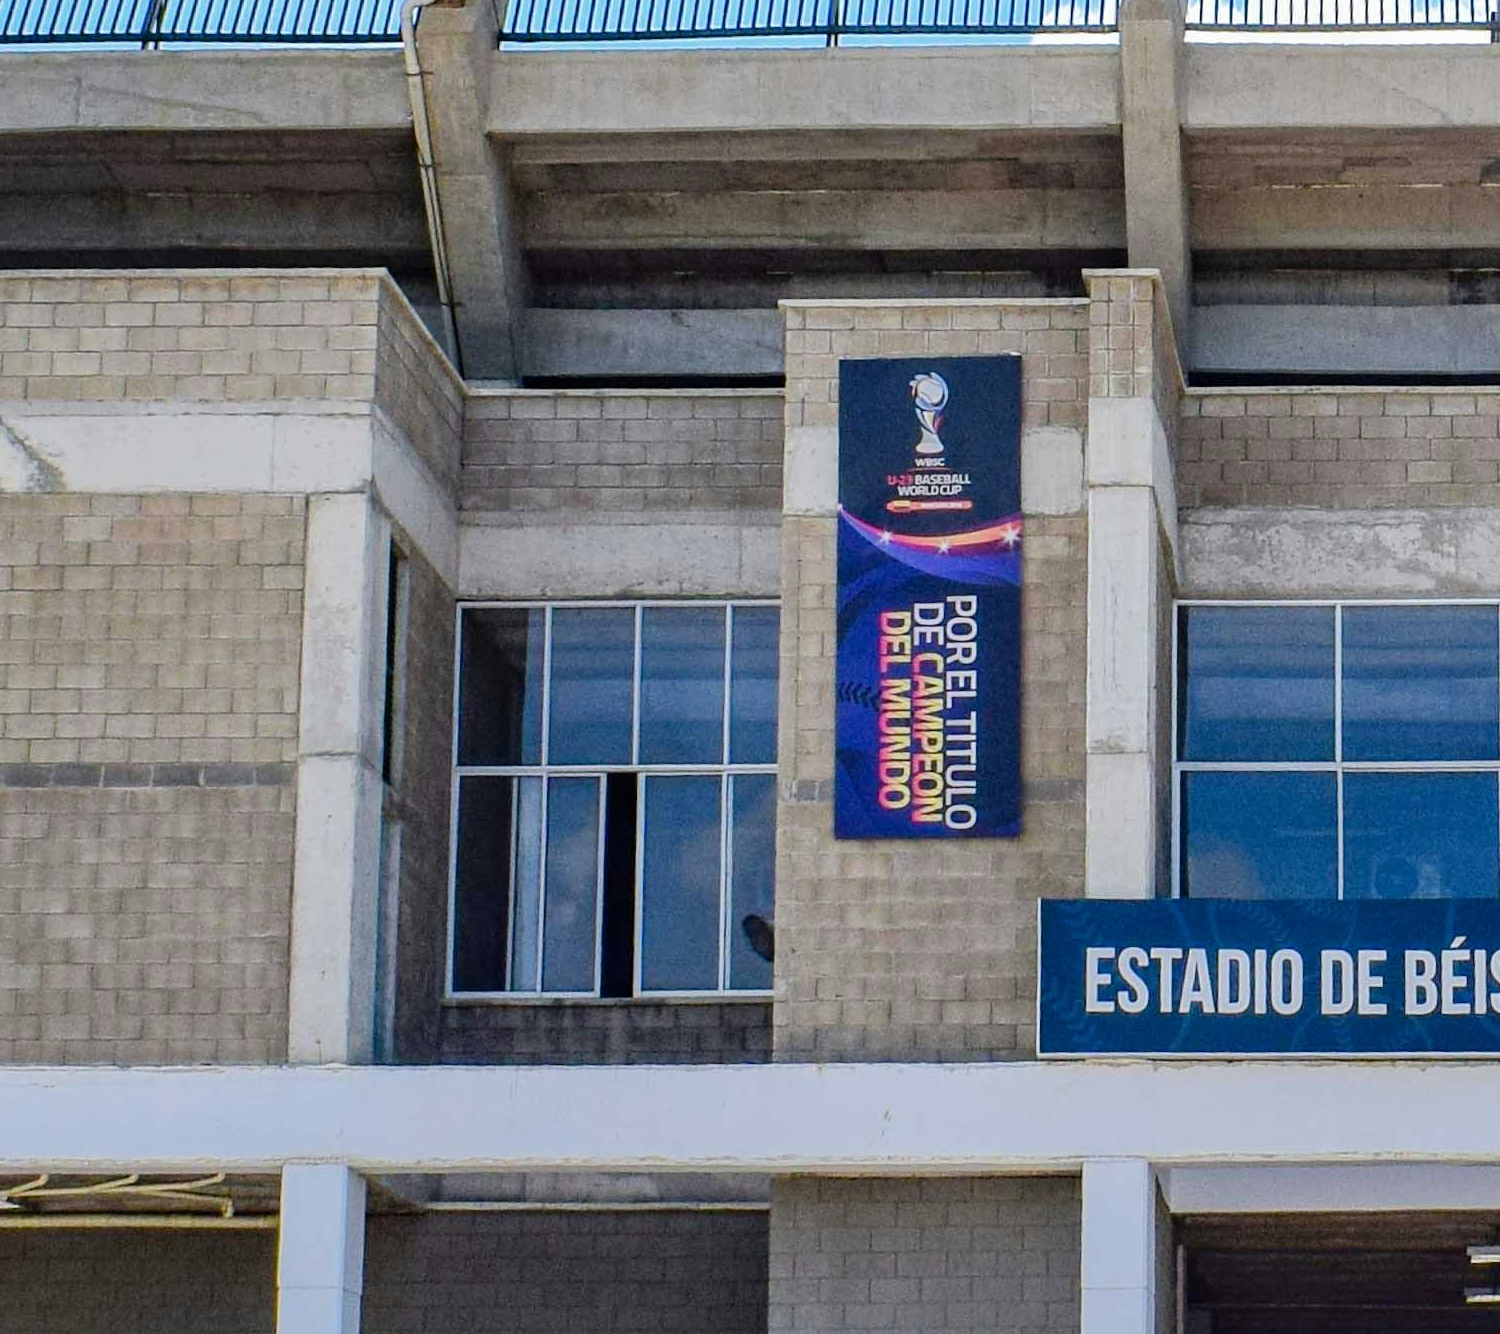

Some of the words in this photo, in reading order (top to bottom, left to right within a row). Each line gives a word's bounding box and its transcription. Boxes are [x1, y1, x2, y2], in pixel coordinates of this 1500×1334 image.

[897, 485, 939, 496] WORLD
[939, 484, 962, 495] CUP
[915, 458, 945, 467] WBSC
[915, 474, 971, 484] BASEBALL
[878, 611, 911, 673] DEL
[913, 602, 944, 646] DE
[946, 595, 977, 664] POR
[946, 670, 977, 709] EL
[878, 678, 911, 810] MUNDO
[911, 652, 944, 824] CAMPEON
[946, 711, 977, 830] TITULO
[1085, 946, 1304, 1015] ESTADIO
[1321, 949, 1387, 1015] DE
